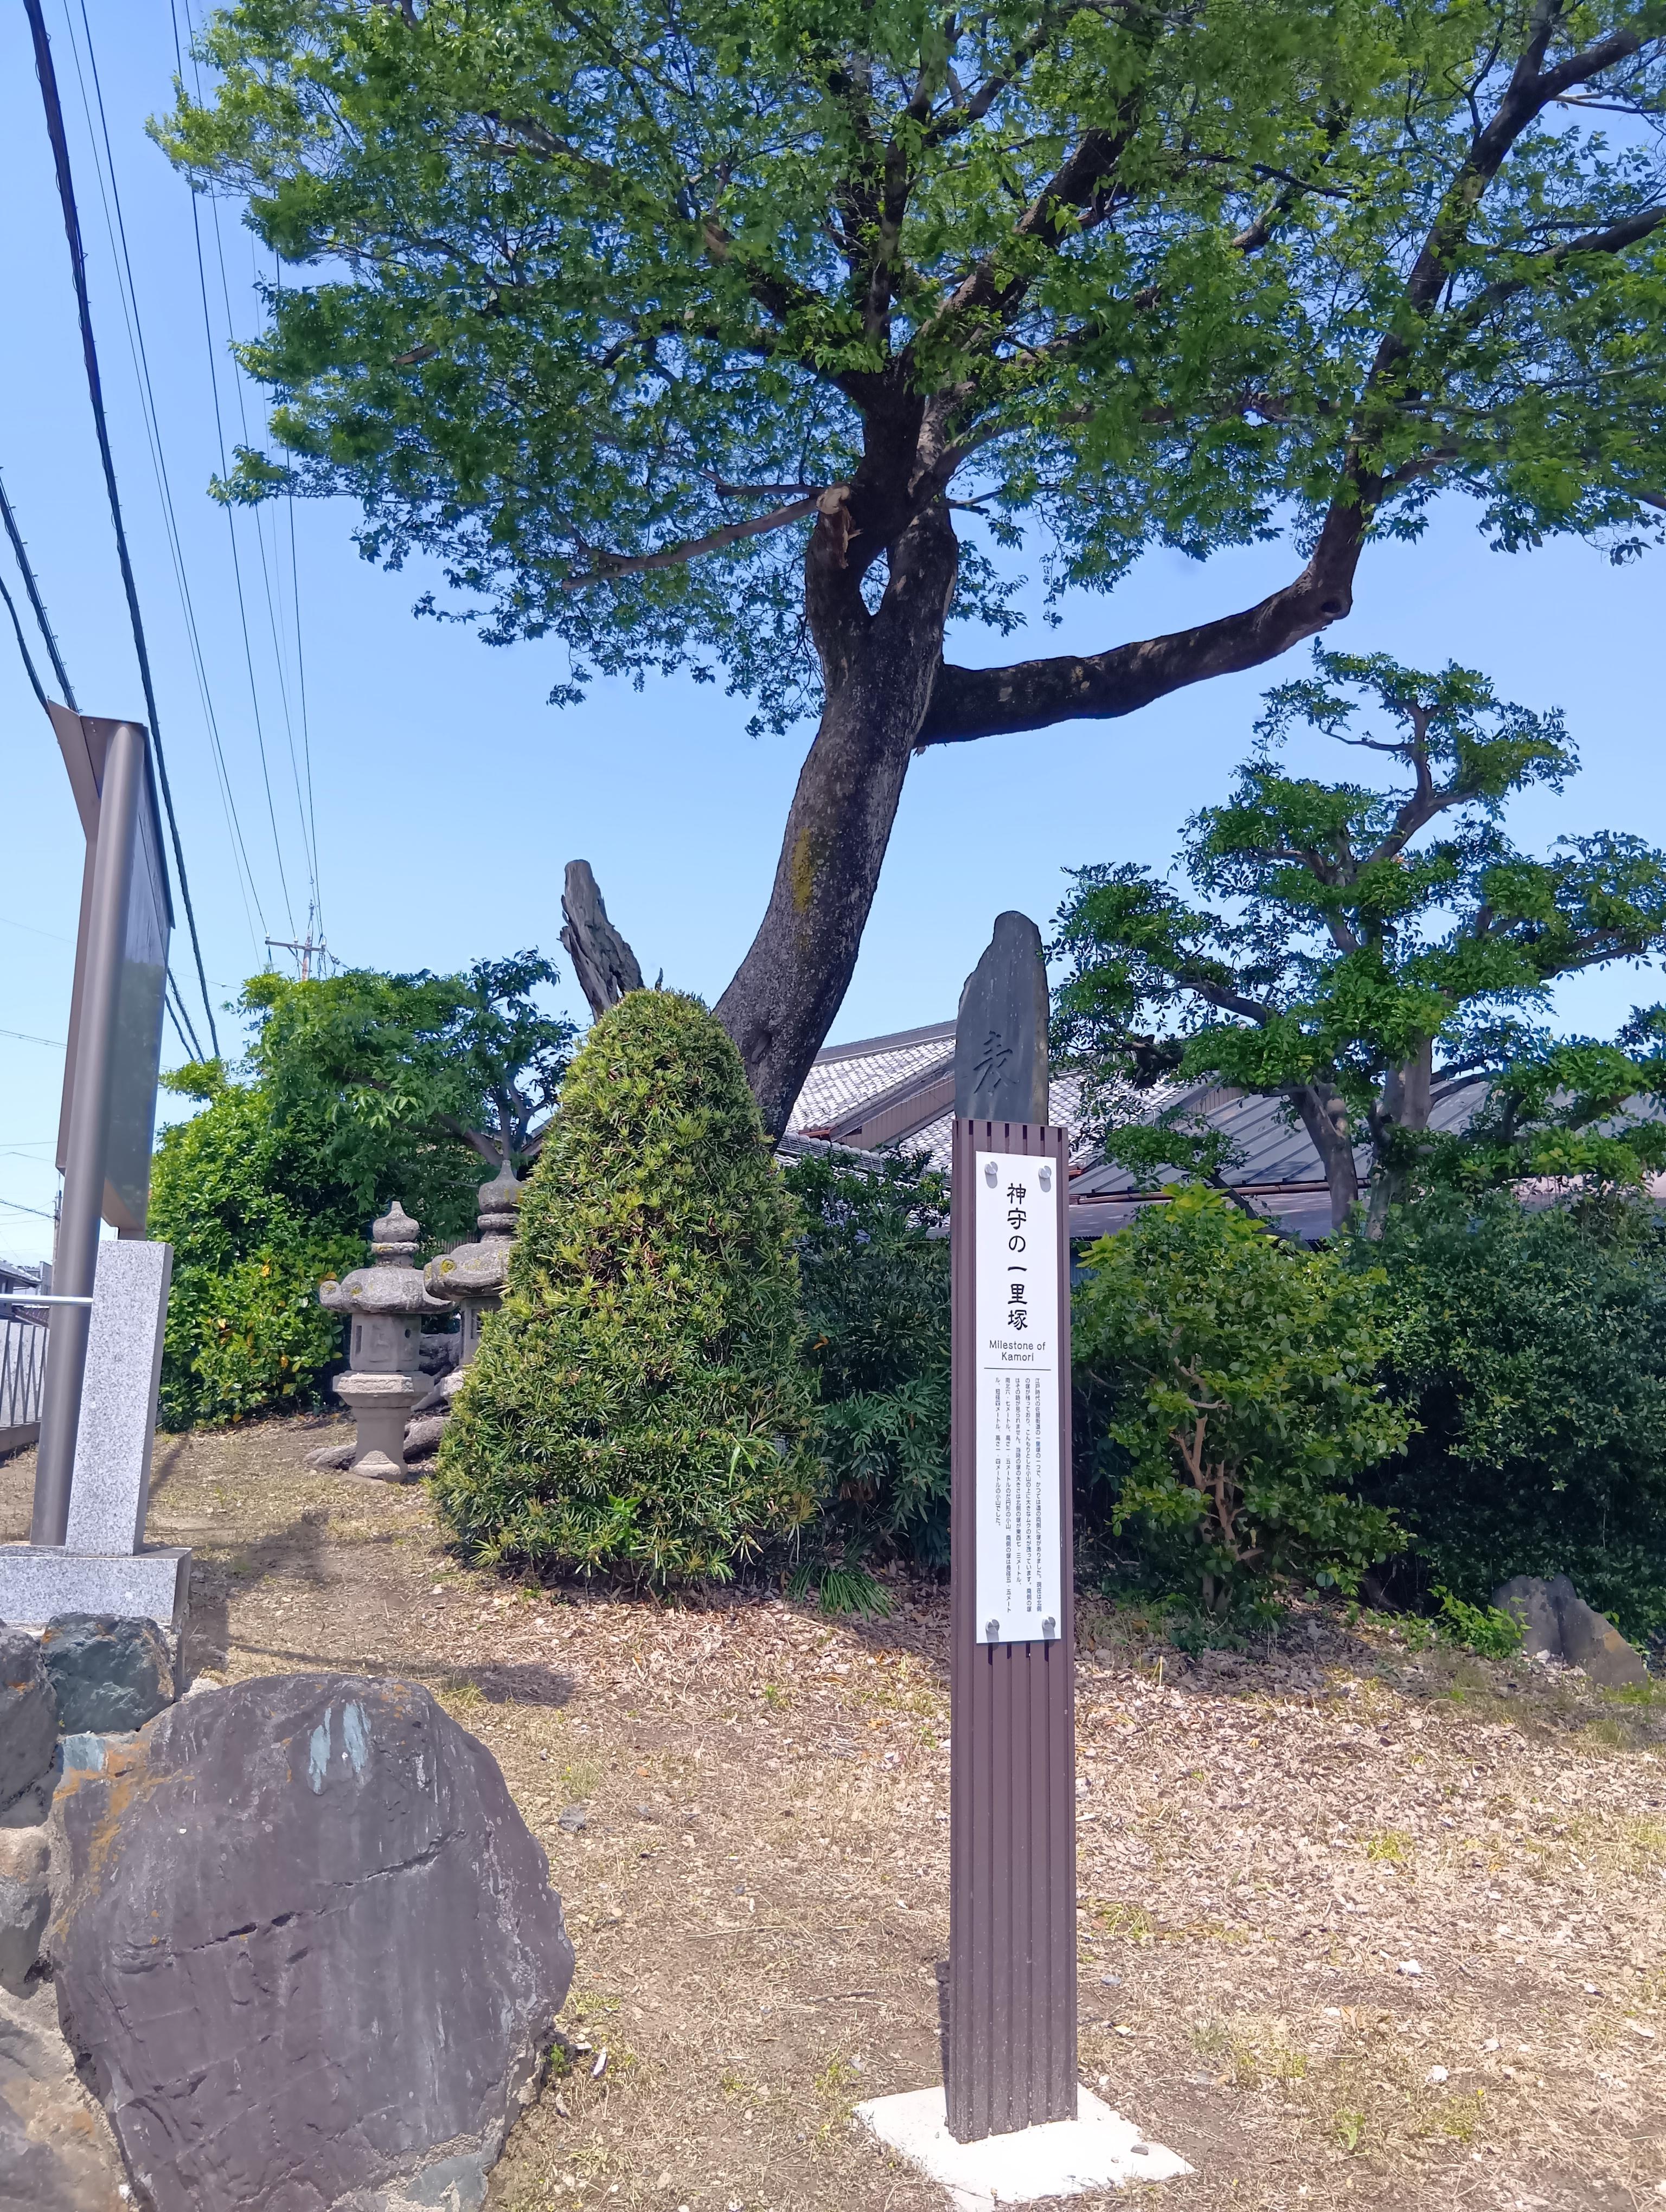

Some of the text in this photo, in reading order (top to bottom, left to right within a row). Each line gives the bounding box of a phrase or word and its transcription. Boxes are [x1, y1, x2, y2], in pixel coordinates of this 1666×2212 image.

[1006, 1182, 1028, 1331] 神守の一里塚
[989, 1340, 1046, 1351] Milestone of
[1002, 1352, 1034, 1361] Kamori
